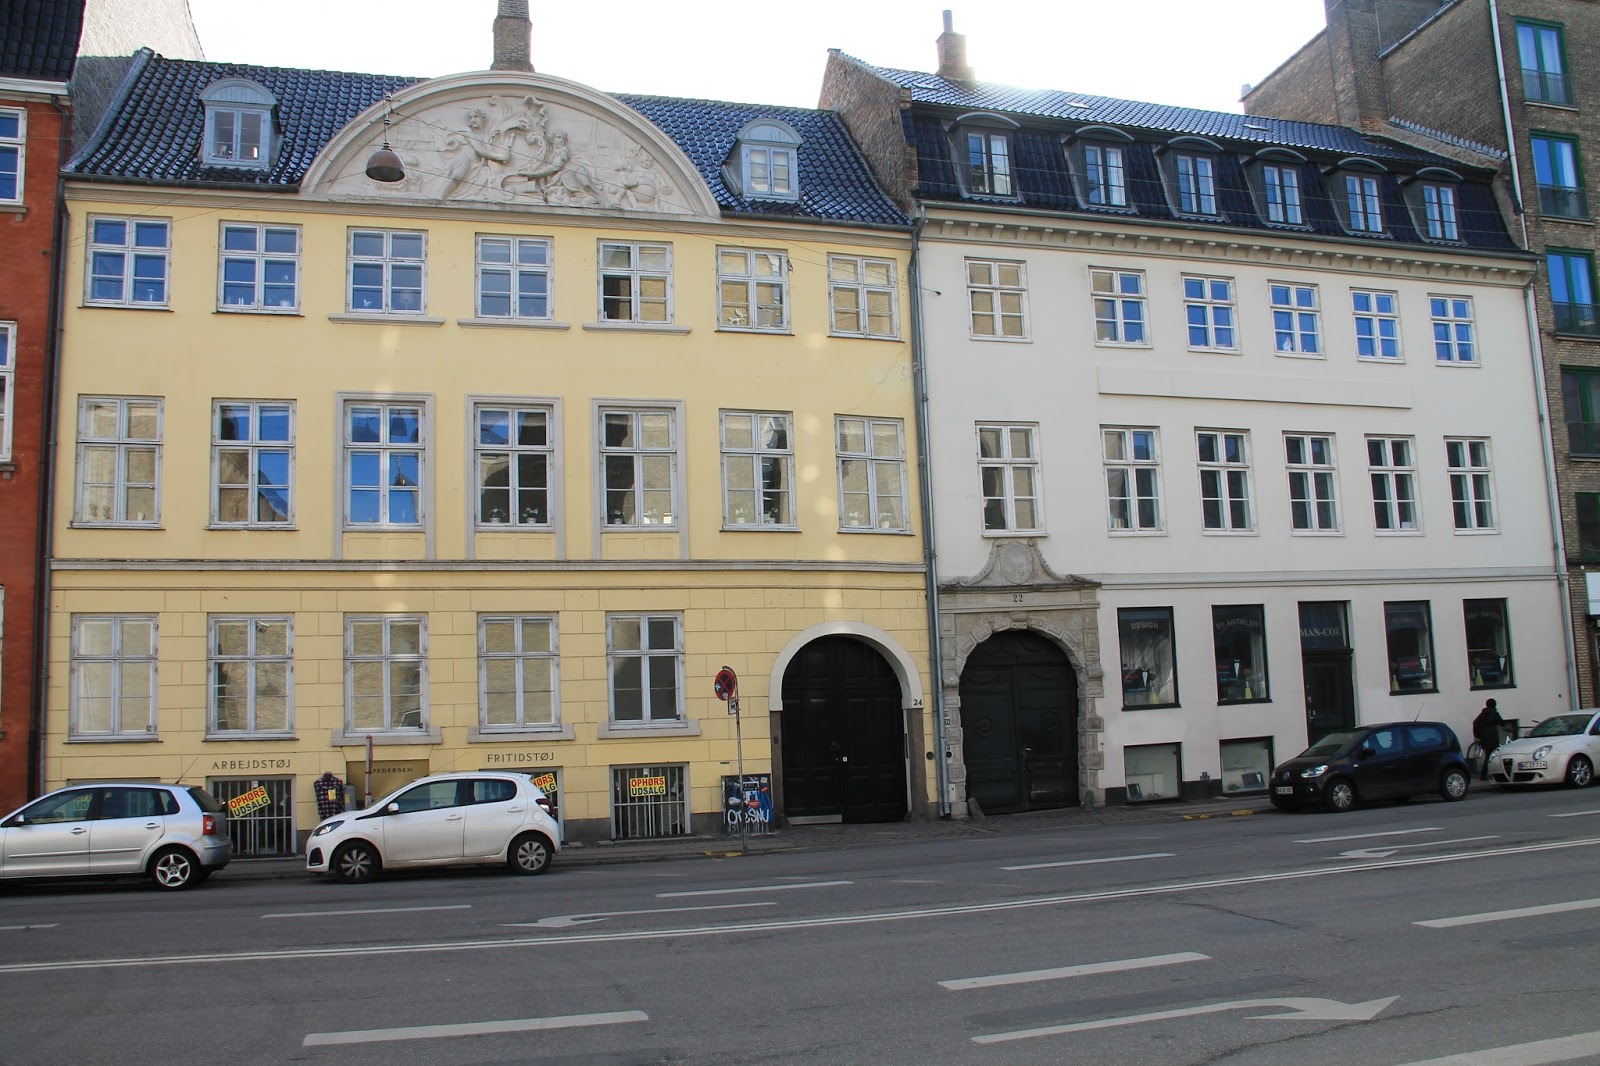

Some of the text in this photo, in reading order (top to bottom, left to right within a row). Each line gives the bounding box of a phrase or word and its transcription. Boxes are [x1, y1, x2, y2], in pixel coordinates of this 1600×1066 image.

[1013, 594, 1023, 602] 22
[1226, 618, 1258, 627] ARTIKLER
[487, 752, 554, 762] FRITIDSTØJ
[212, 759, 291, 769] ARBEJDSTØJ
[631, 777, 664, 787] OPHØRS
[631, 786, 664, 796] UDSALG
[230, 787, 265, 809] OPHØRS
[233, 796, 269, 817] UDSALG
